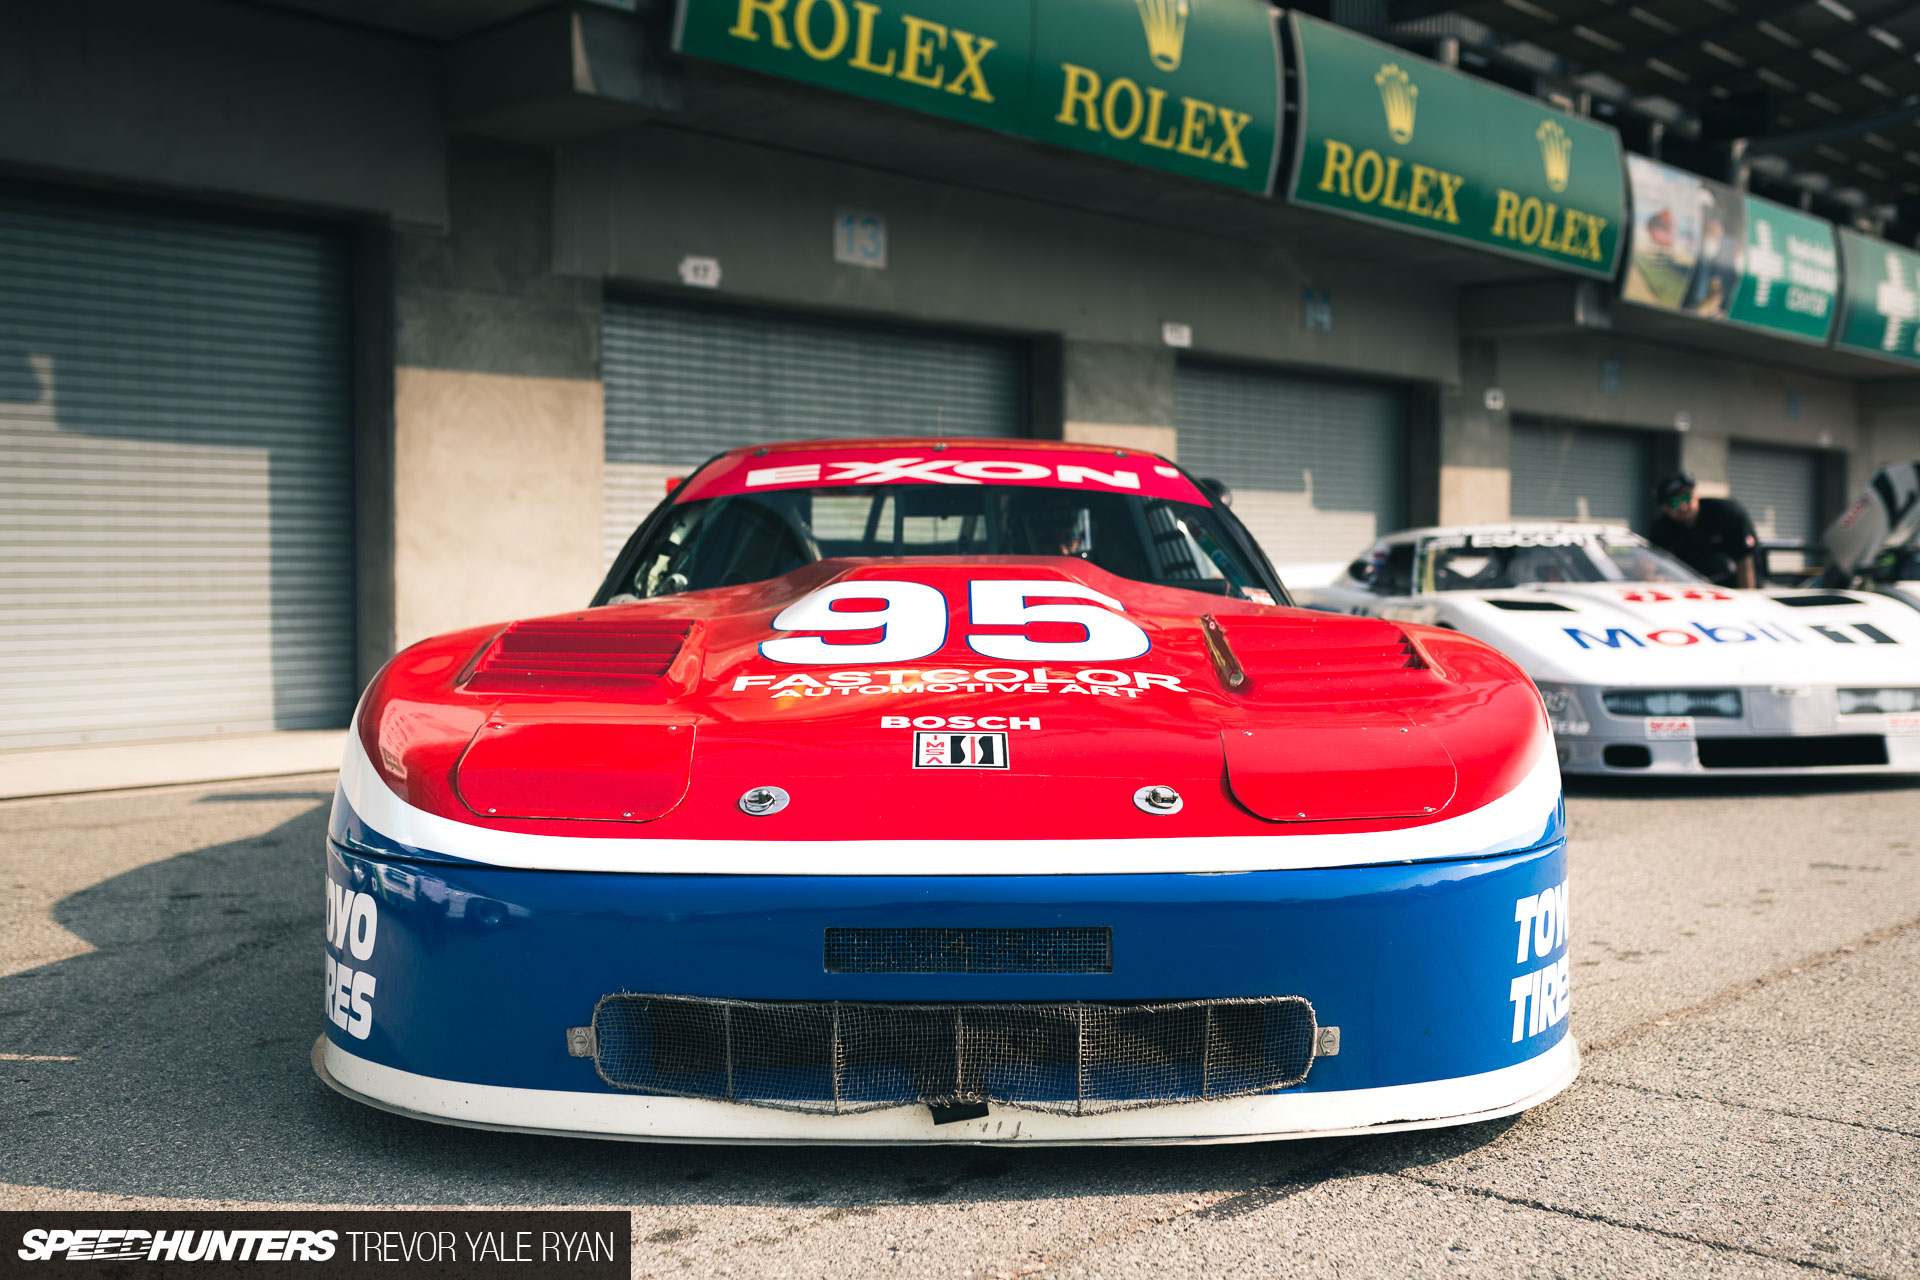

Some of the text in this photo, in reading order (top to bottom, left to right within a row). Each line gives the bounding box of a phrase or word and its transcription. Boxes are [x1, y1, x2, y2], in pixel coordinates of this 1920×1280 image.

[728, 0, 998, 103] ROLEX
[1055, 62, 1253, 169] ROLEX
[1317, 138, 1465, 225] ROLEX
[840, 216, 882, 260] 13
[1491, 188, 1607, 262] ROLEX
[745, 457, 1141, 490] EXXON
[757, 579, 1152, 665] 95
[1562, 620, 1802, 650] Mobil
[732, 669, 1189, 692] FASTCOLOR
[770, 683, 1144, 699] AUTOMOTIVE ART
[880, 716, 1041, 731] BOSCH
[925, 735, 945, 764] IMSA
[326, 872, 377, 961] OYO
[1514, 875, 1569, 964] TOY
[326, 951, 377, 1040] RES
[1509, 952, 1569, 1044] TIRE
